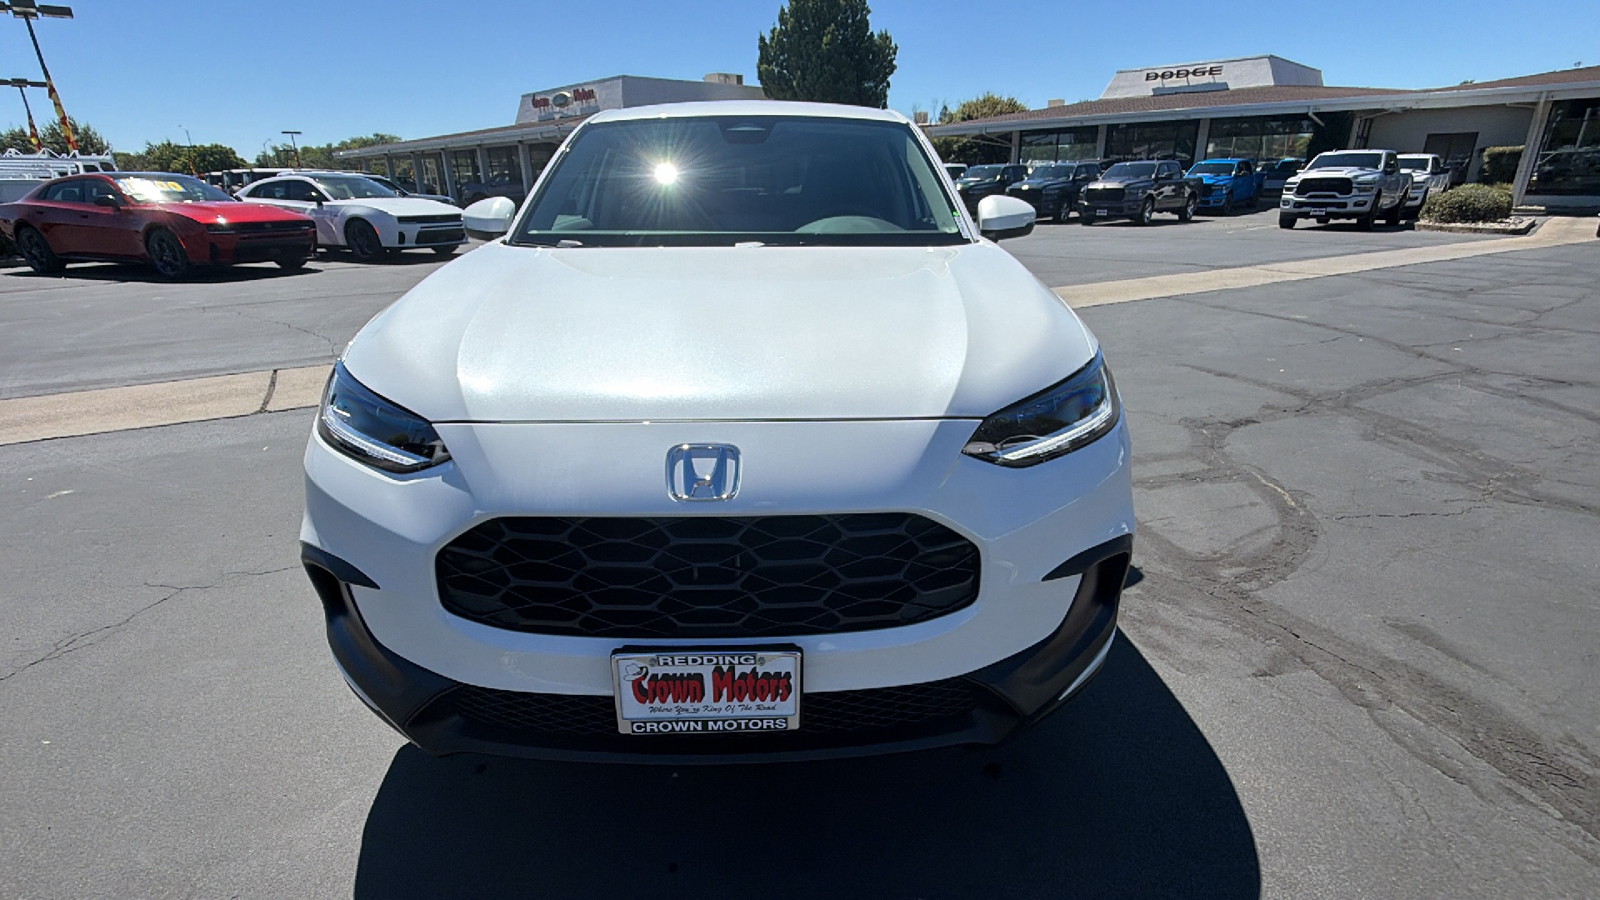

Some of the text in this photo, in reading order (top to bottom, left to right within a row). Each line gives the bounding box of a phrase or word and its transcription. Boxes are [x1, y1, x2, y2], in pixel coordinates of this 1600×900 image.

[1145, 66, 1224, 81] DODGE
[659, 656, 755, 666] REDDING
[631, 666, 792, 705] Crown Motors
[648, 705, 673, 714] Where
[702, 704, 722, 713] King
[724, 704, 736, 713] Of
[632, 719, 787, 732] CROWN MOTORS
